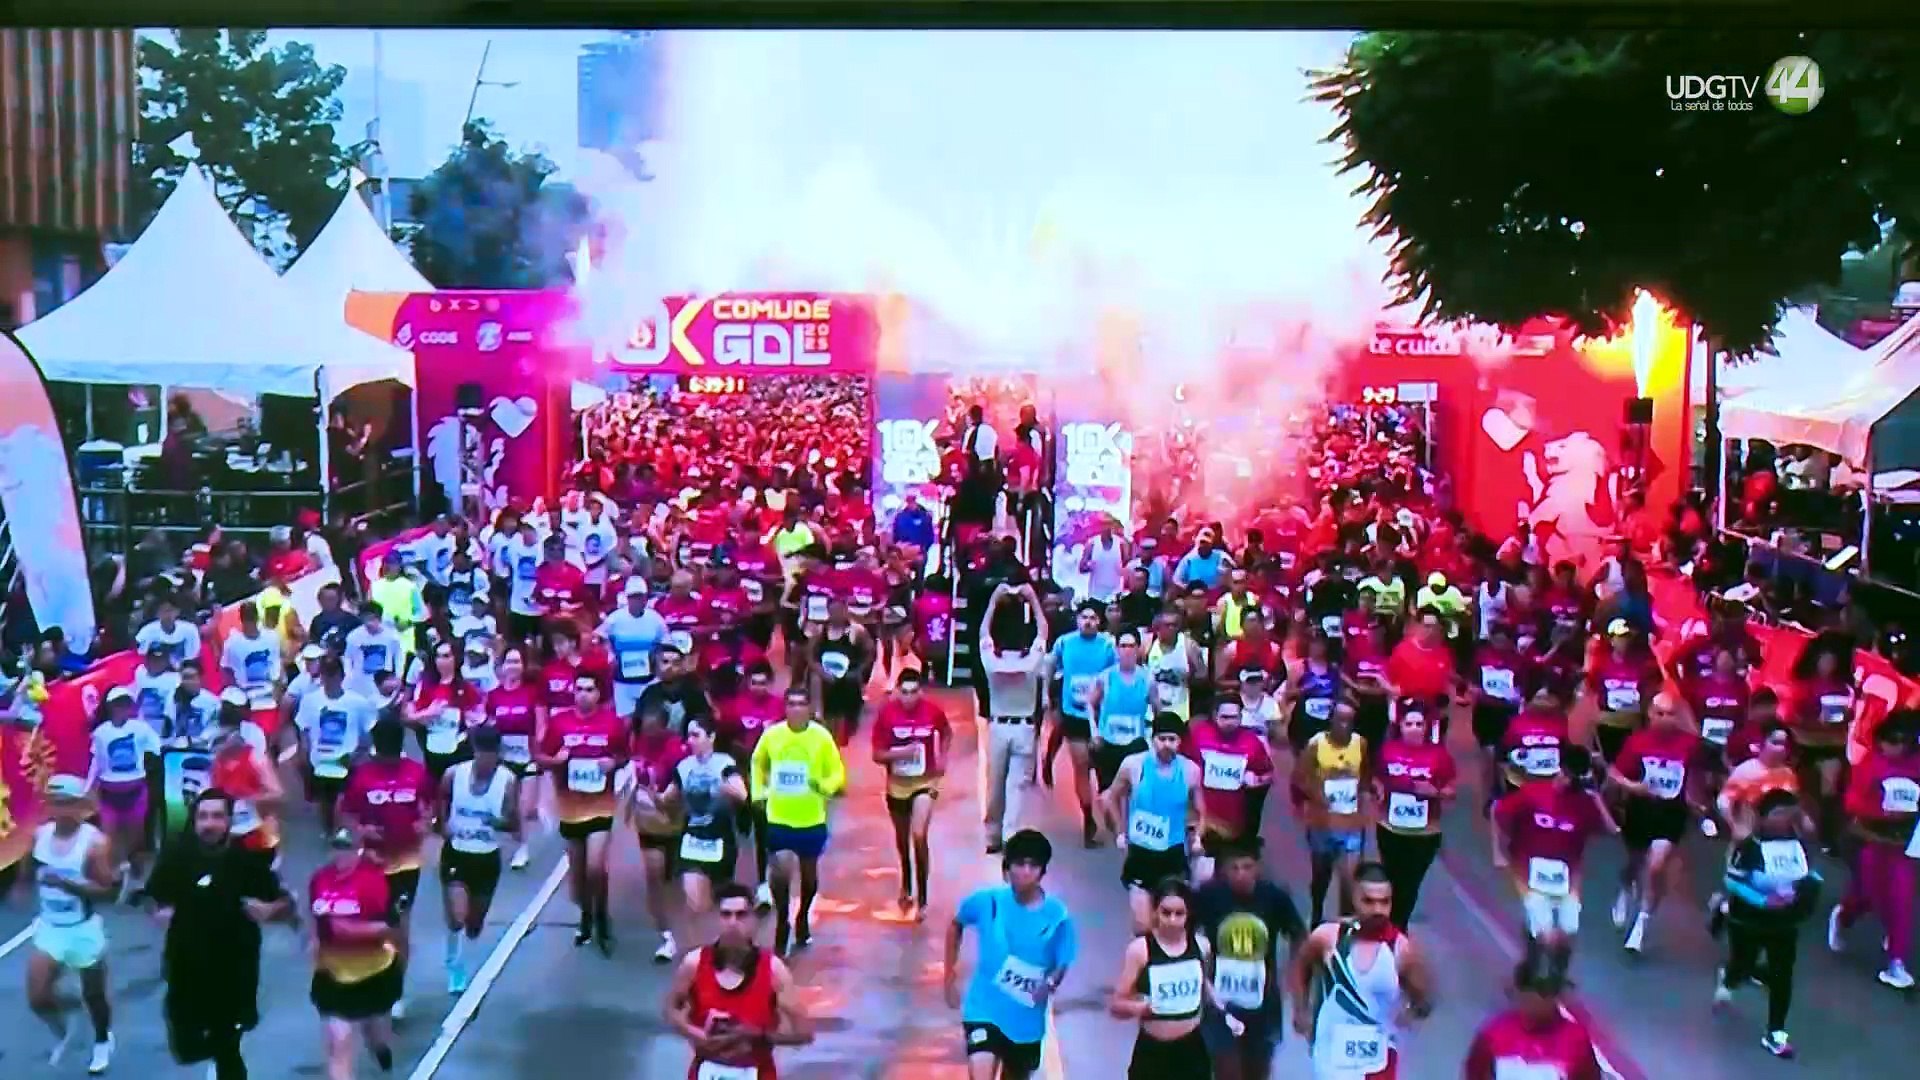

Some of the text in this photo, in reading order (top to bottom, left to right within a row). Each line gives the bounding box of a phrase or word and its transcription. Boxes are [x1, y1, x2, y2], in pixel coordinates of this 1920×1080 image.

[713, 300, 831, 320] COMUDE
[713, 322, 831, 366] GDL
[1345, 1041, 1379, 1058] 858
